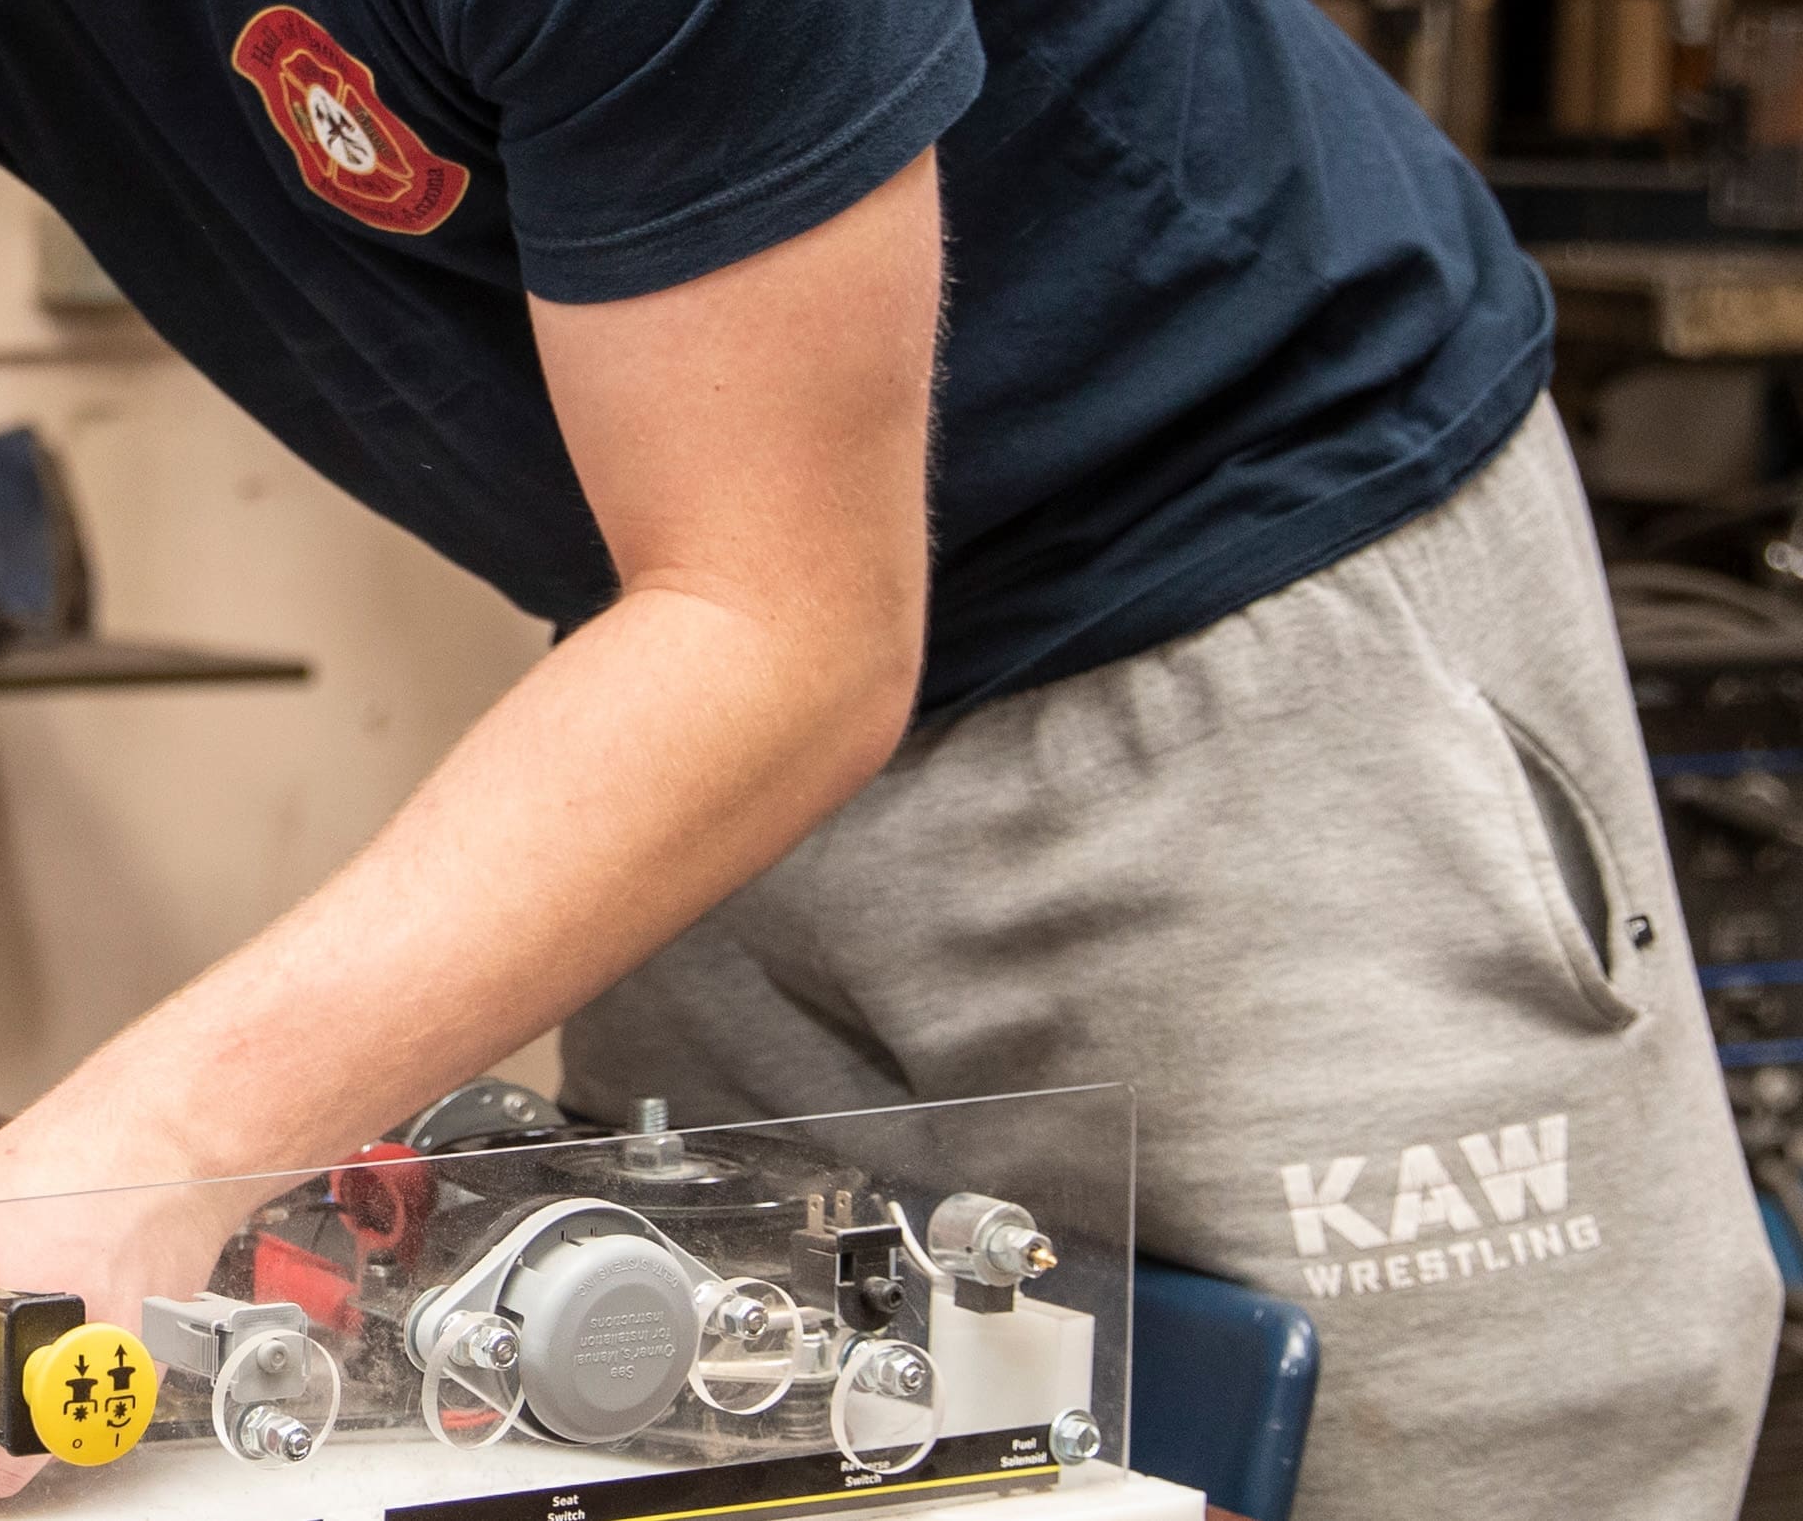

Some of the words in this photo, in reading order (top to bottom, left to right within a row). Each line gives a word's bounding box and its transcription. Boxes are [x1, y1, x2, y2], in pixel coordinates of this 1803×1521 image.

[1280, 1113, 1569, 1258] KAW
[1303, 1214, 1602, 1298] WRESTLING
[1012, 1437, 1037, 1451] Fuel
[1000, 1451, 1047, 1468] Solenoid
[845, 1474, 882, 1487] Switch
[552, 1494, 579, 1507] Seat
[547, 1509, 586, 1521] Switch
